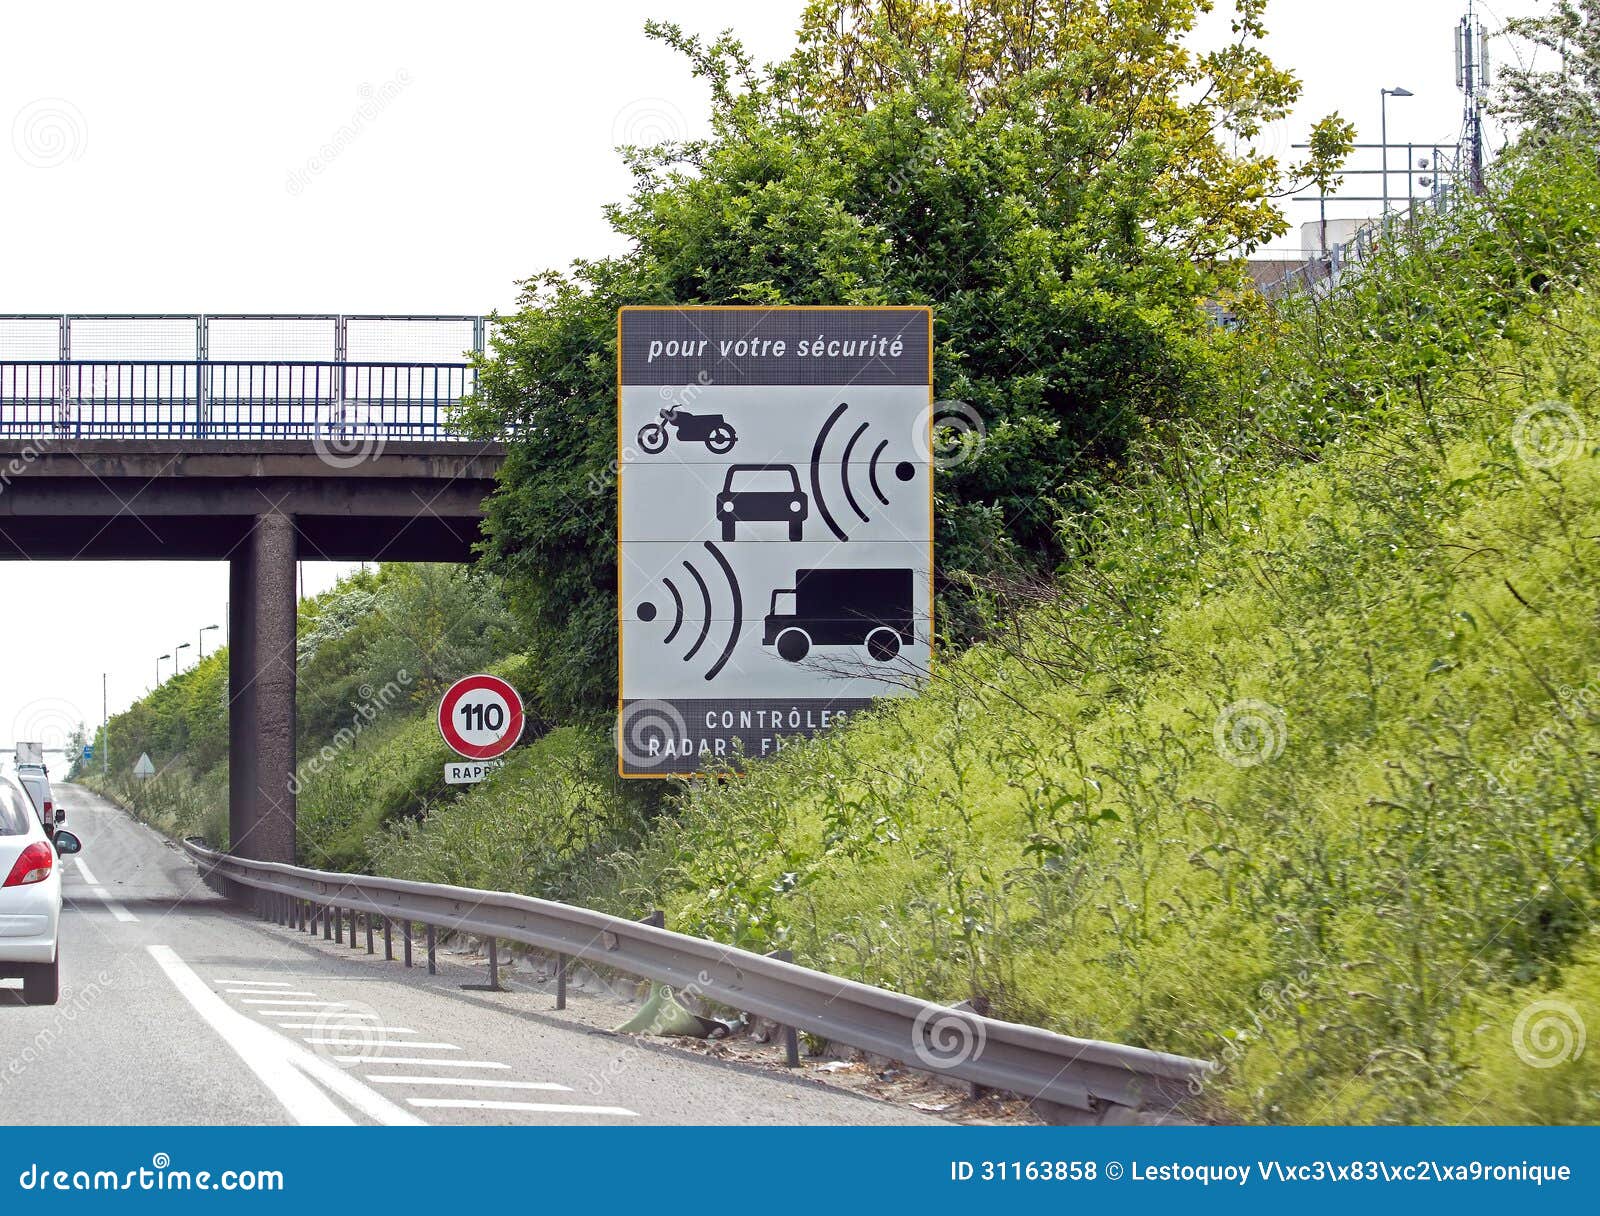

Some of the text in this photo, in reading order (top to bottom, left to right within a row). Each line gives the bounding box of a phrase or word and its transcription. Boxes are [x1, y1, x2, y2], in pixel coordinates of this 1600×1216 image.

[648, 334, 904, 362] pour votre sécurité
[461, 703, 504, 731] 110
[649, 738, 742, 756] RADAR
[452, 766, 491, 779] RAPP
